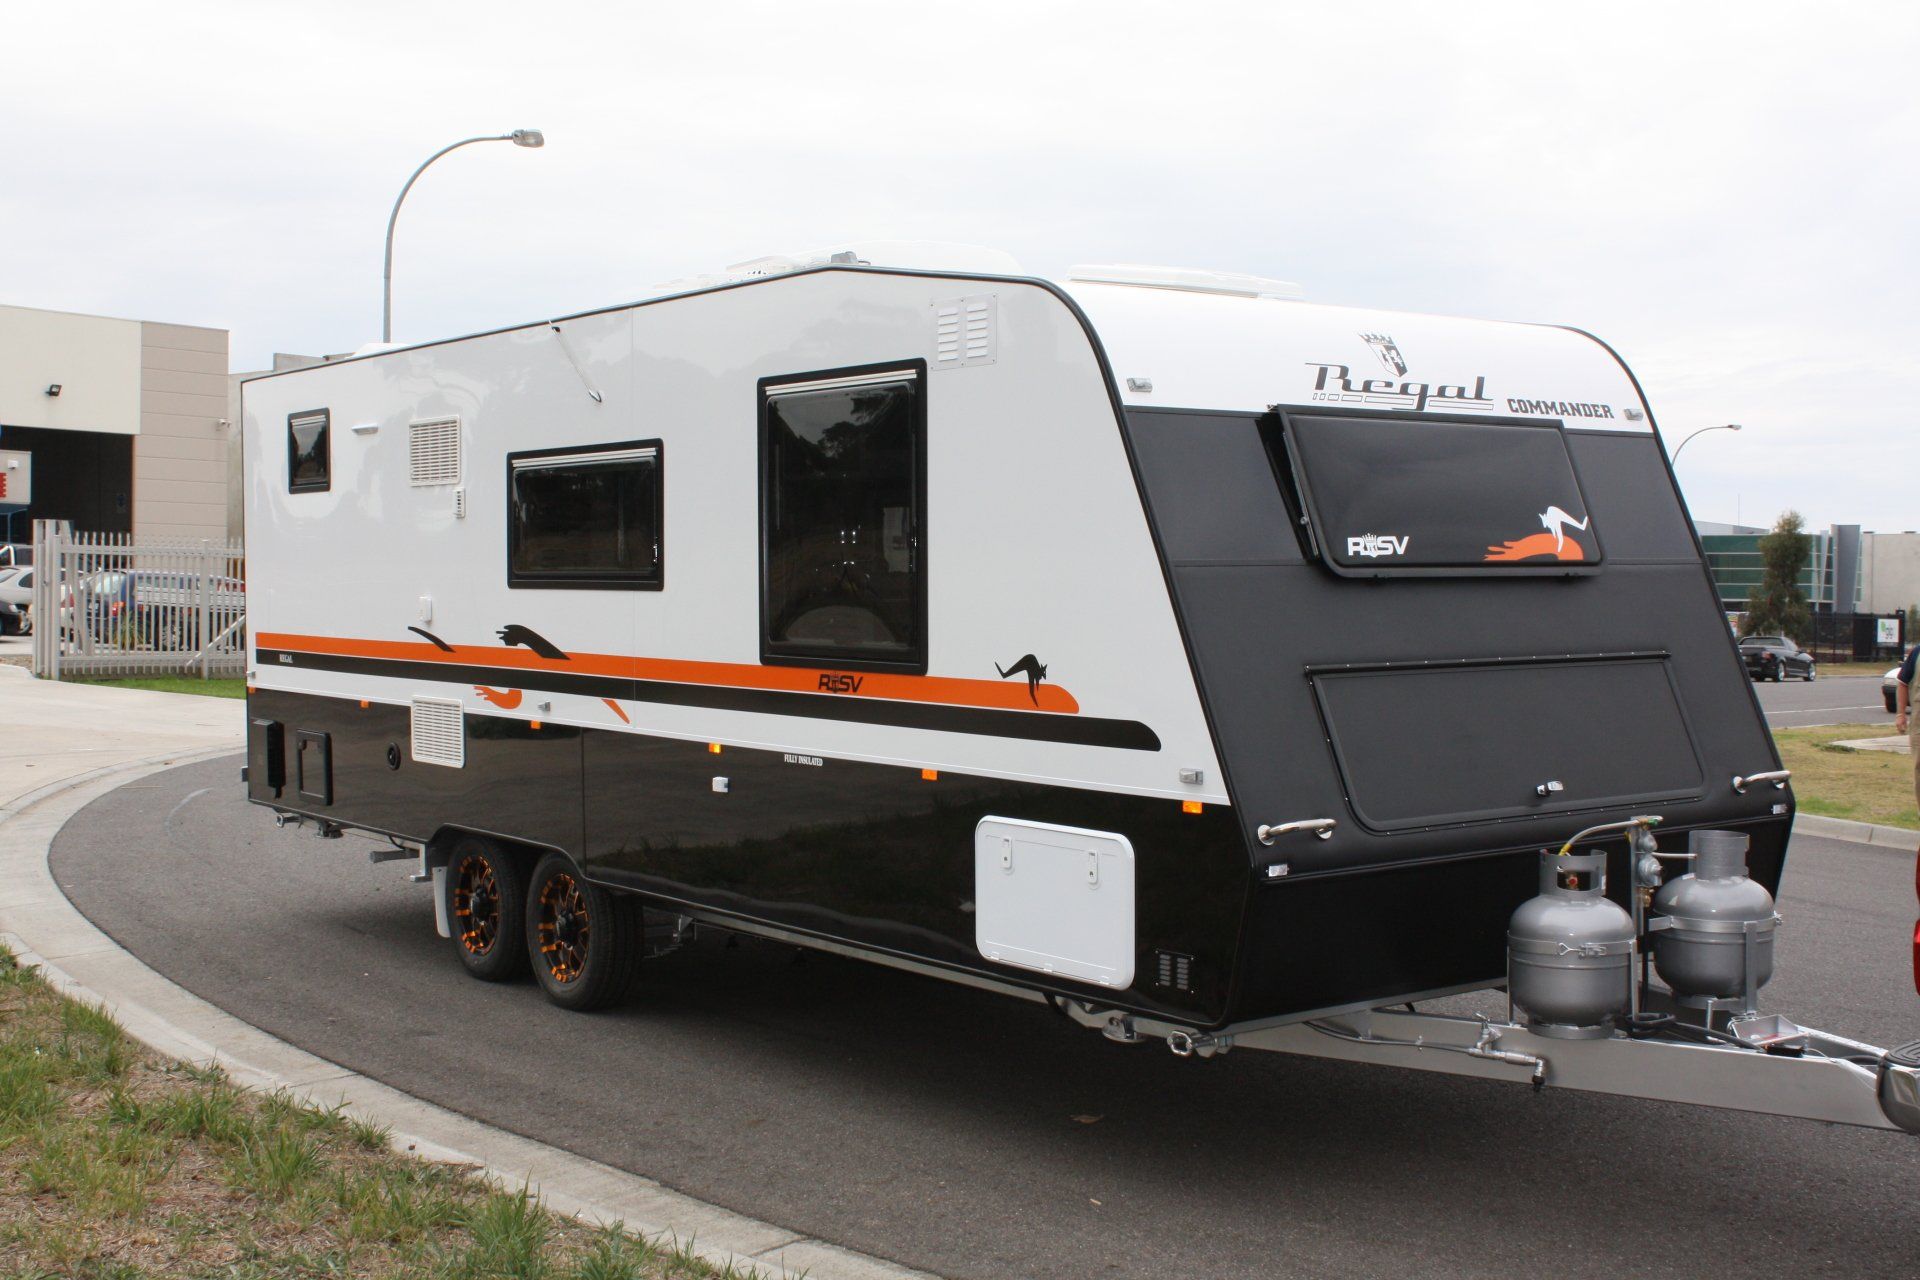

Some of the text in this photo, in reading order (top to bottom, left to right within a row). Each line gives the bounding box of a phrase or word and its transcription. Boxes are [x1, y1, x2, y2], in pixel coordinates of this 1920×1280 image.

[1305, 362, 1494, 412] Regal
[1506, 398, 1615, 419] COMMANDER
[784, 753, 798, 764] FULLY
